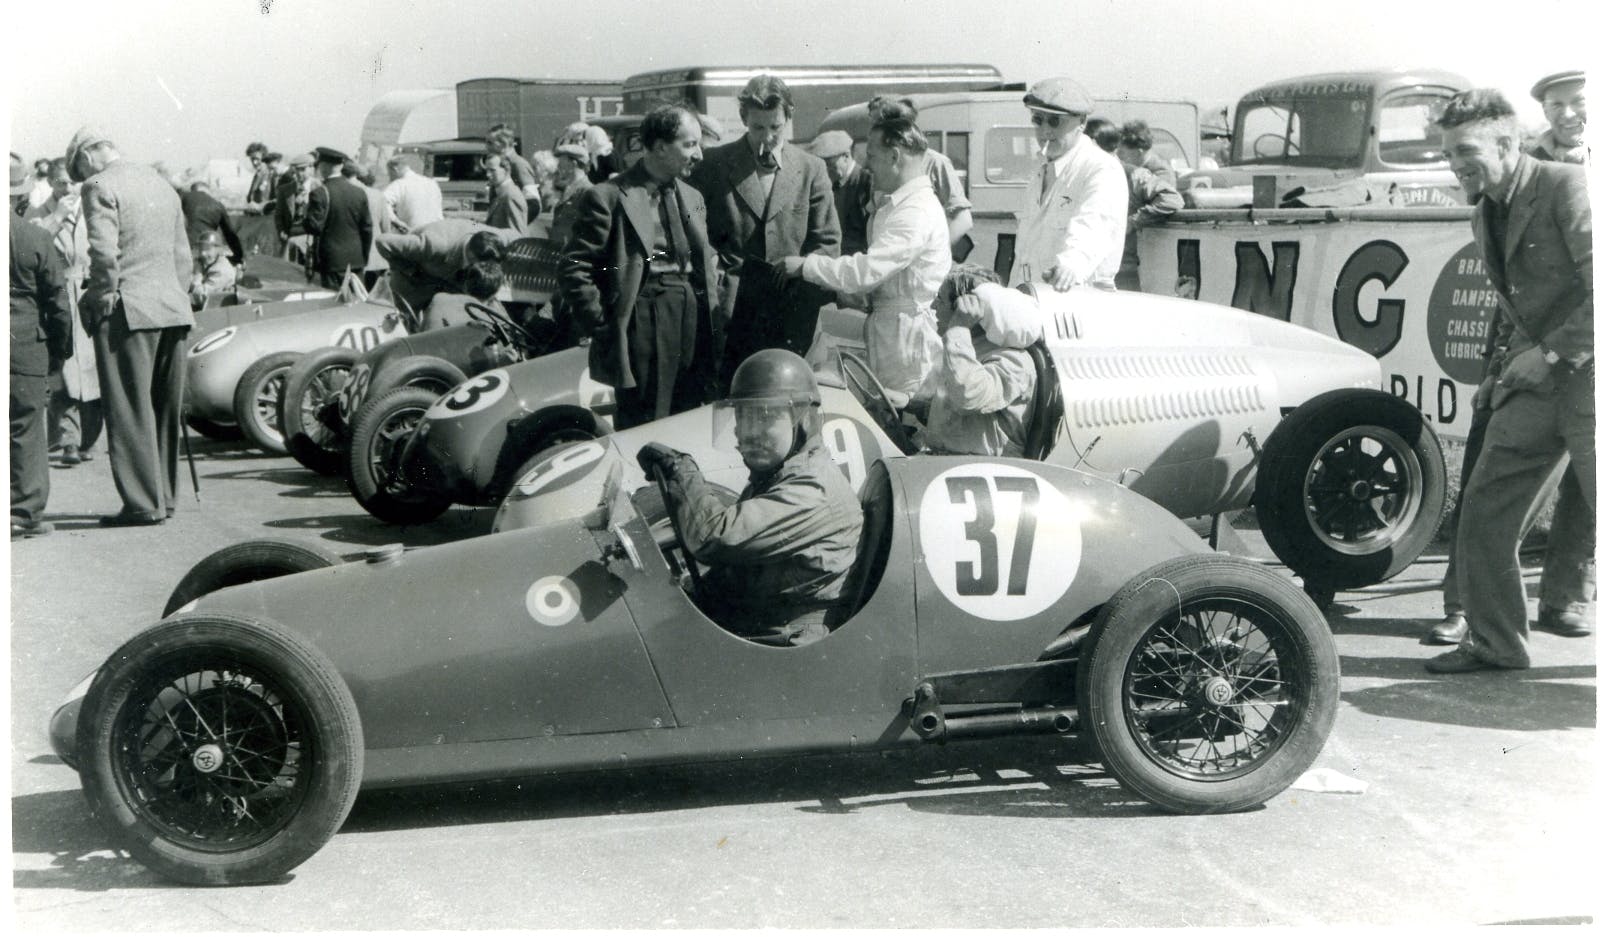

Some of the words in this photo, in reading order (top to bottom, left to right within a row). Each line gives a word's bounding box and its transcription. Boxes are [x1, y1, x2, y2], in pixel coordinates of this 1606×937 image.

[1457, 258, 1487, 276] BRA
[1451, 289, 1499, 308] DAMPER
[1447, 319, 1489, 338] CHASSI
[944, 475, 1041, 597] 37
